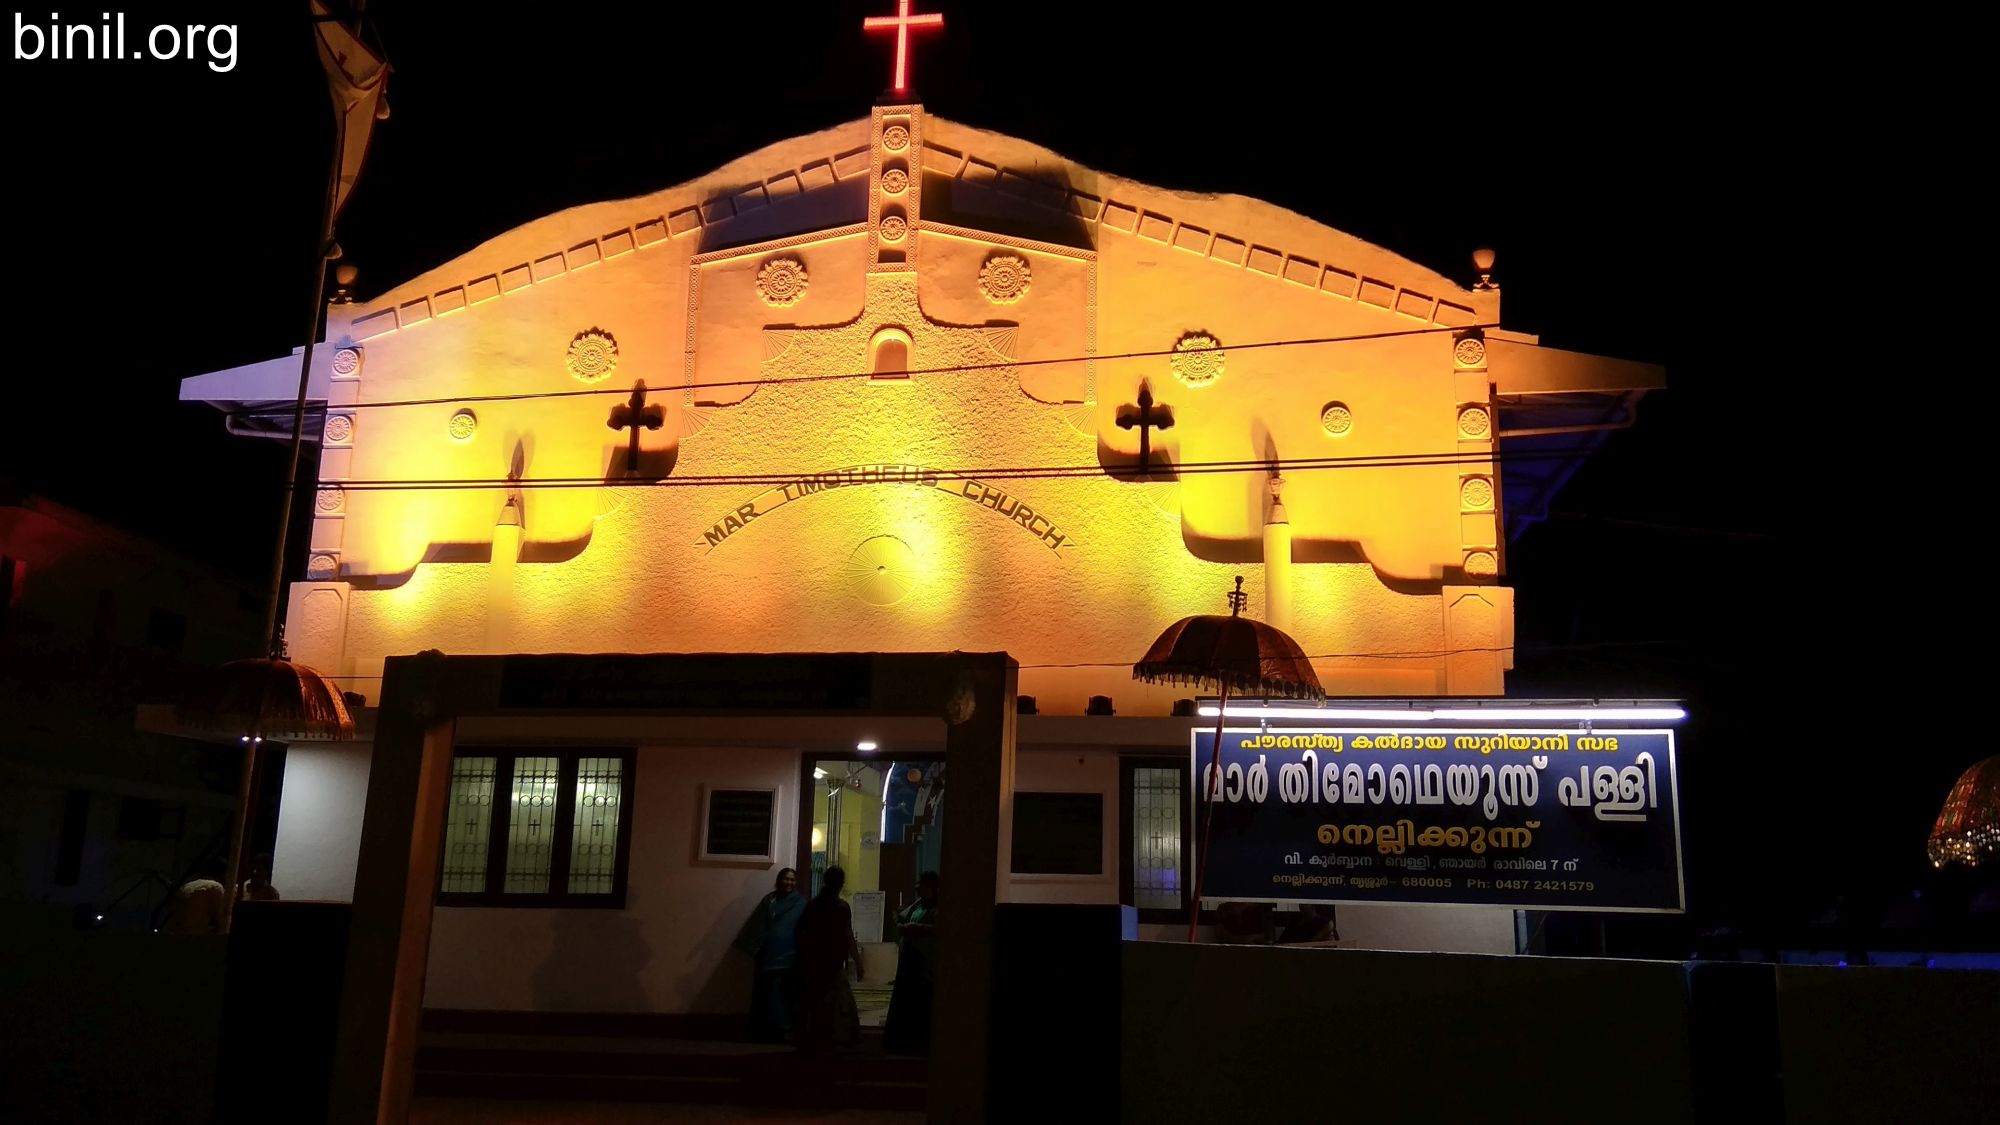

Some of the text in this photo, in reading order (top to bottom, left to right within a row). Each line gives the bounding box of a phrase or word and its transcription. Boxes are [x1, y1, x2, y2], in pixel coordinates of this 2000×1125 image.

[703, 465, 1066, 549] MAR TIMOTHEUS CHURCH
[1454, 734, 1569, 754] സുറിയാനി
[1577, 736, 1618, 751] സഭ
[1558, 751, 1657, 822] പള്ളി
[1317, 819, 1541, 854] നെല്ലിക്കുന്ന്
[1493, 857, 1547, 870] രാവിലെ
[1550, 859, 1560, 871] 7
[1402, 877, 1453, 888] 680005
[1466, 878, 1490, 889] Ph:
[1495, 879, 1529, 890] 0487
[1533, 880, 1595, 892] 2421579
